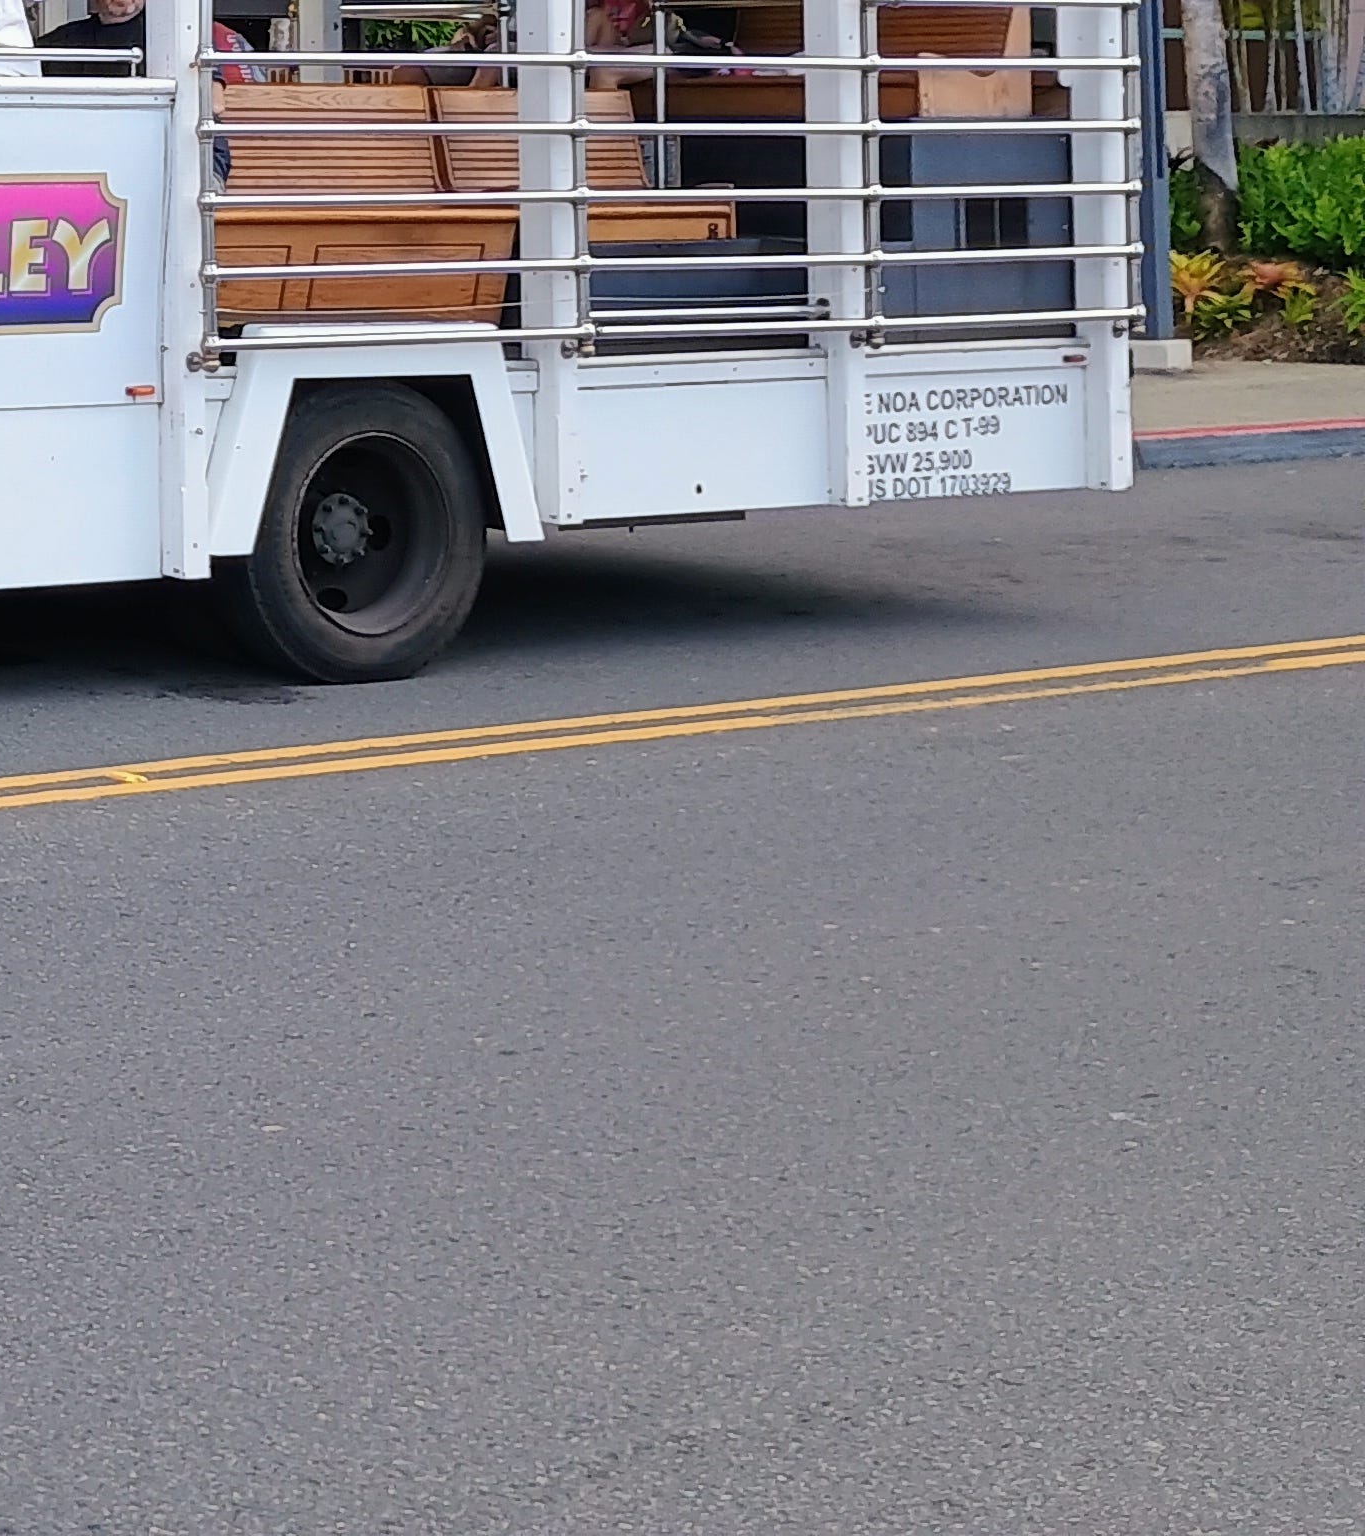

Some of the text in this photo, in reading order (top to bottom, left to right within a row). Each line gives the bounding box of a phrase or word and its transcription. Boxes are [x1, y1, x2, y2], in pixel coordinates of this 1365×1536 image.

[877, 390, 922, 414] NOA
[926, 383, 1069, 412] CORPORATION
[912, 449, 973, 475] 25,900
[892, 474, 932, 498] DOT
